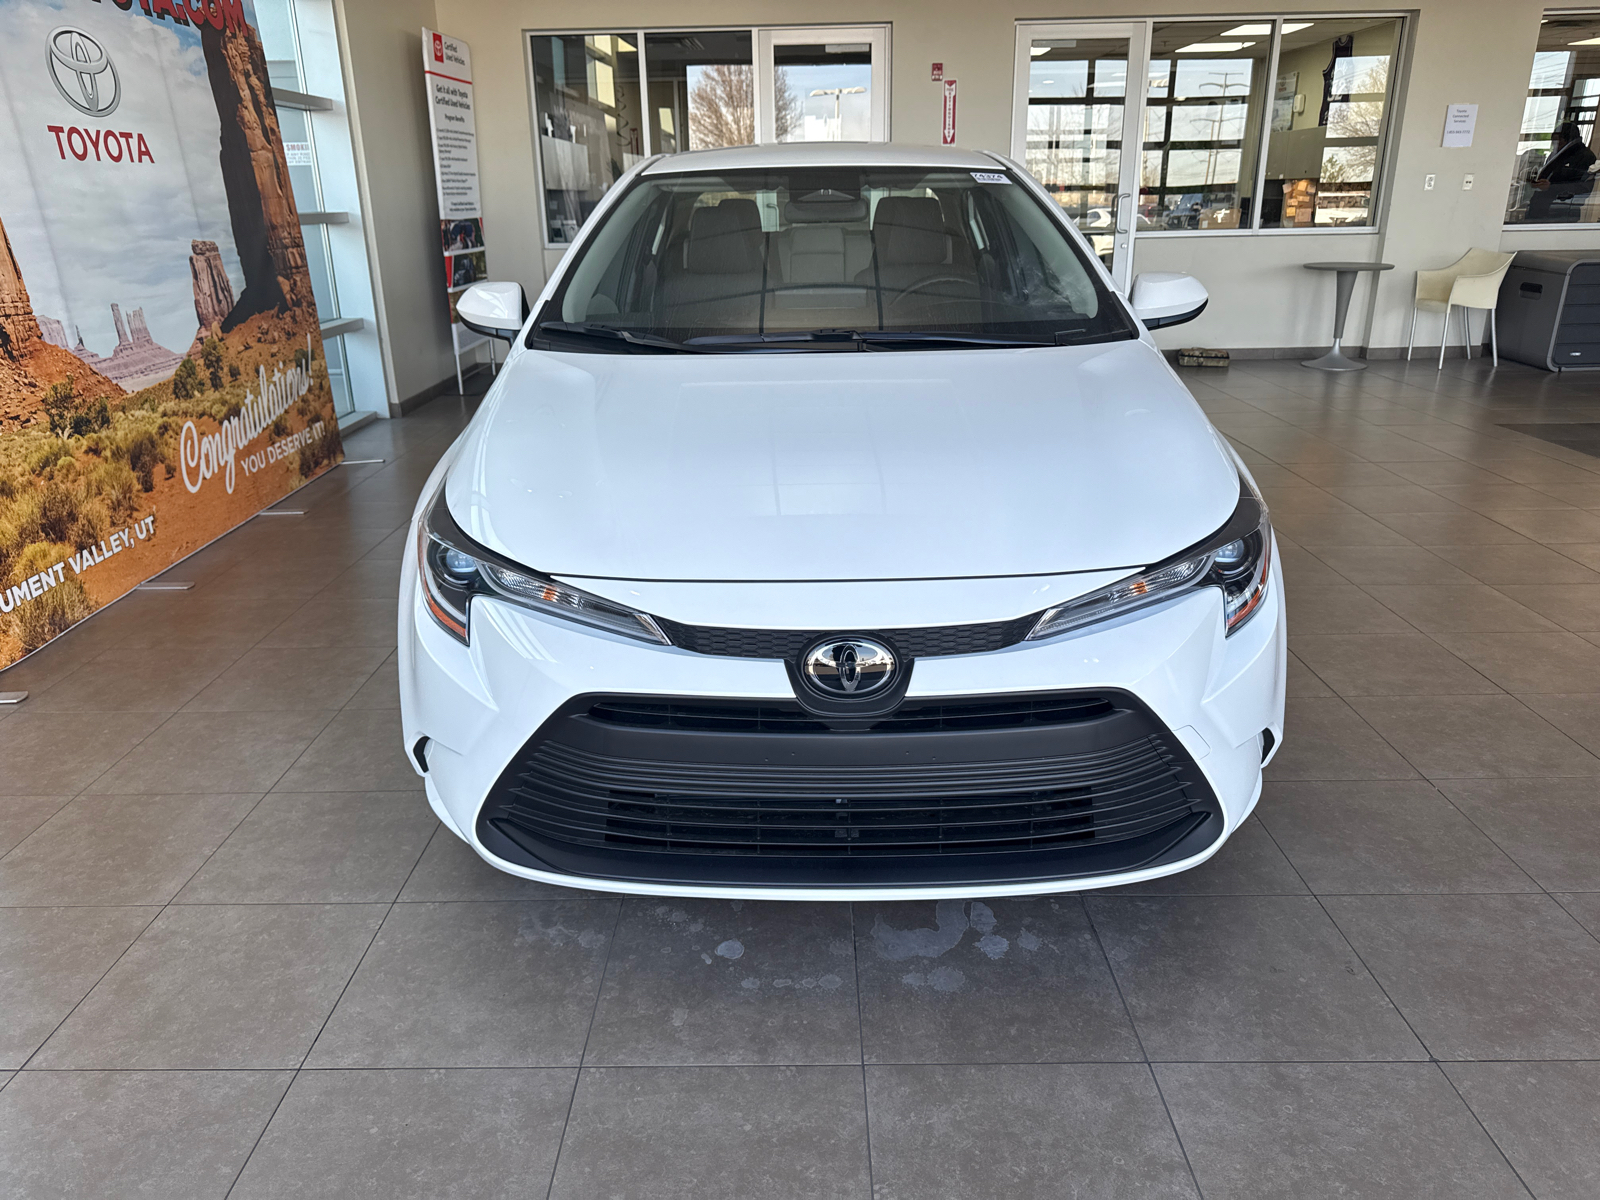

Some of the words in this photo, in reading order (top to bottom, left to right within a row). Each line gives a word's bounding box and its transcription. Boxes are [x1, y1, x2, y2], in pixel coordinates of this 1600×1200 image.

[47, 125, 155, 163] TOYOTA
[180, 333, 314, 494] Congratulations!
[240, 450, 266, 477] YOU
[266, 427, 313, 464] DESERVE
[312, 420, 326, 442] IT!
[0, 561, 65, 616] UMENT
[67, 527, 135, 575] VALLEY,
[134, 515, 155, 540] UT
